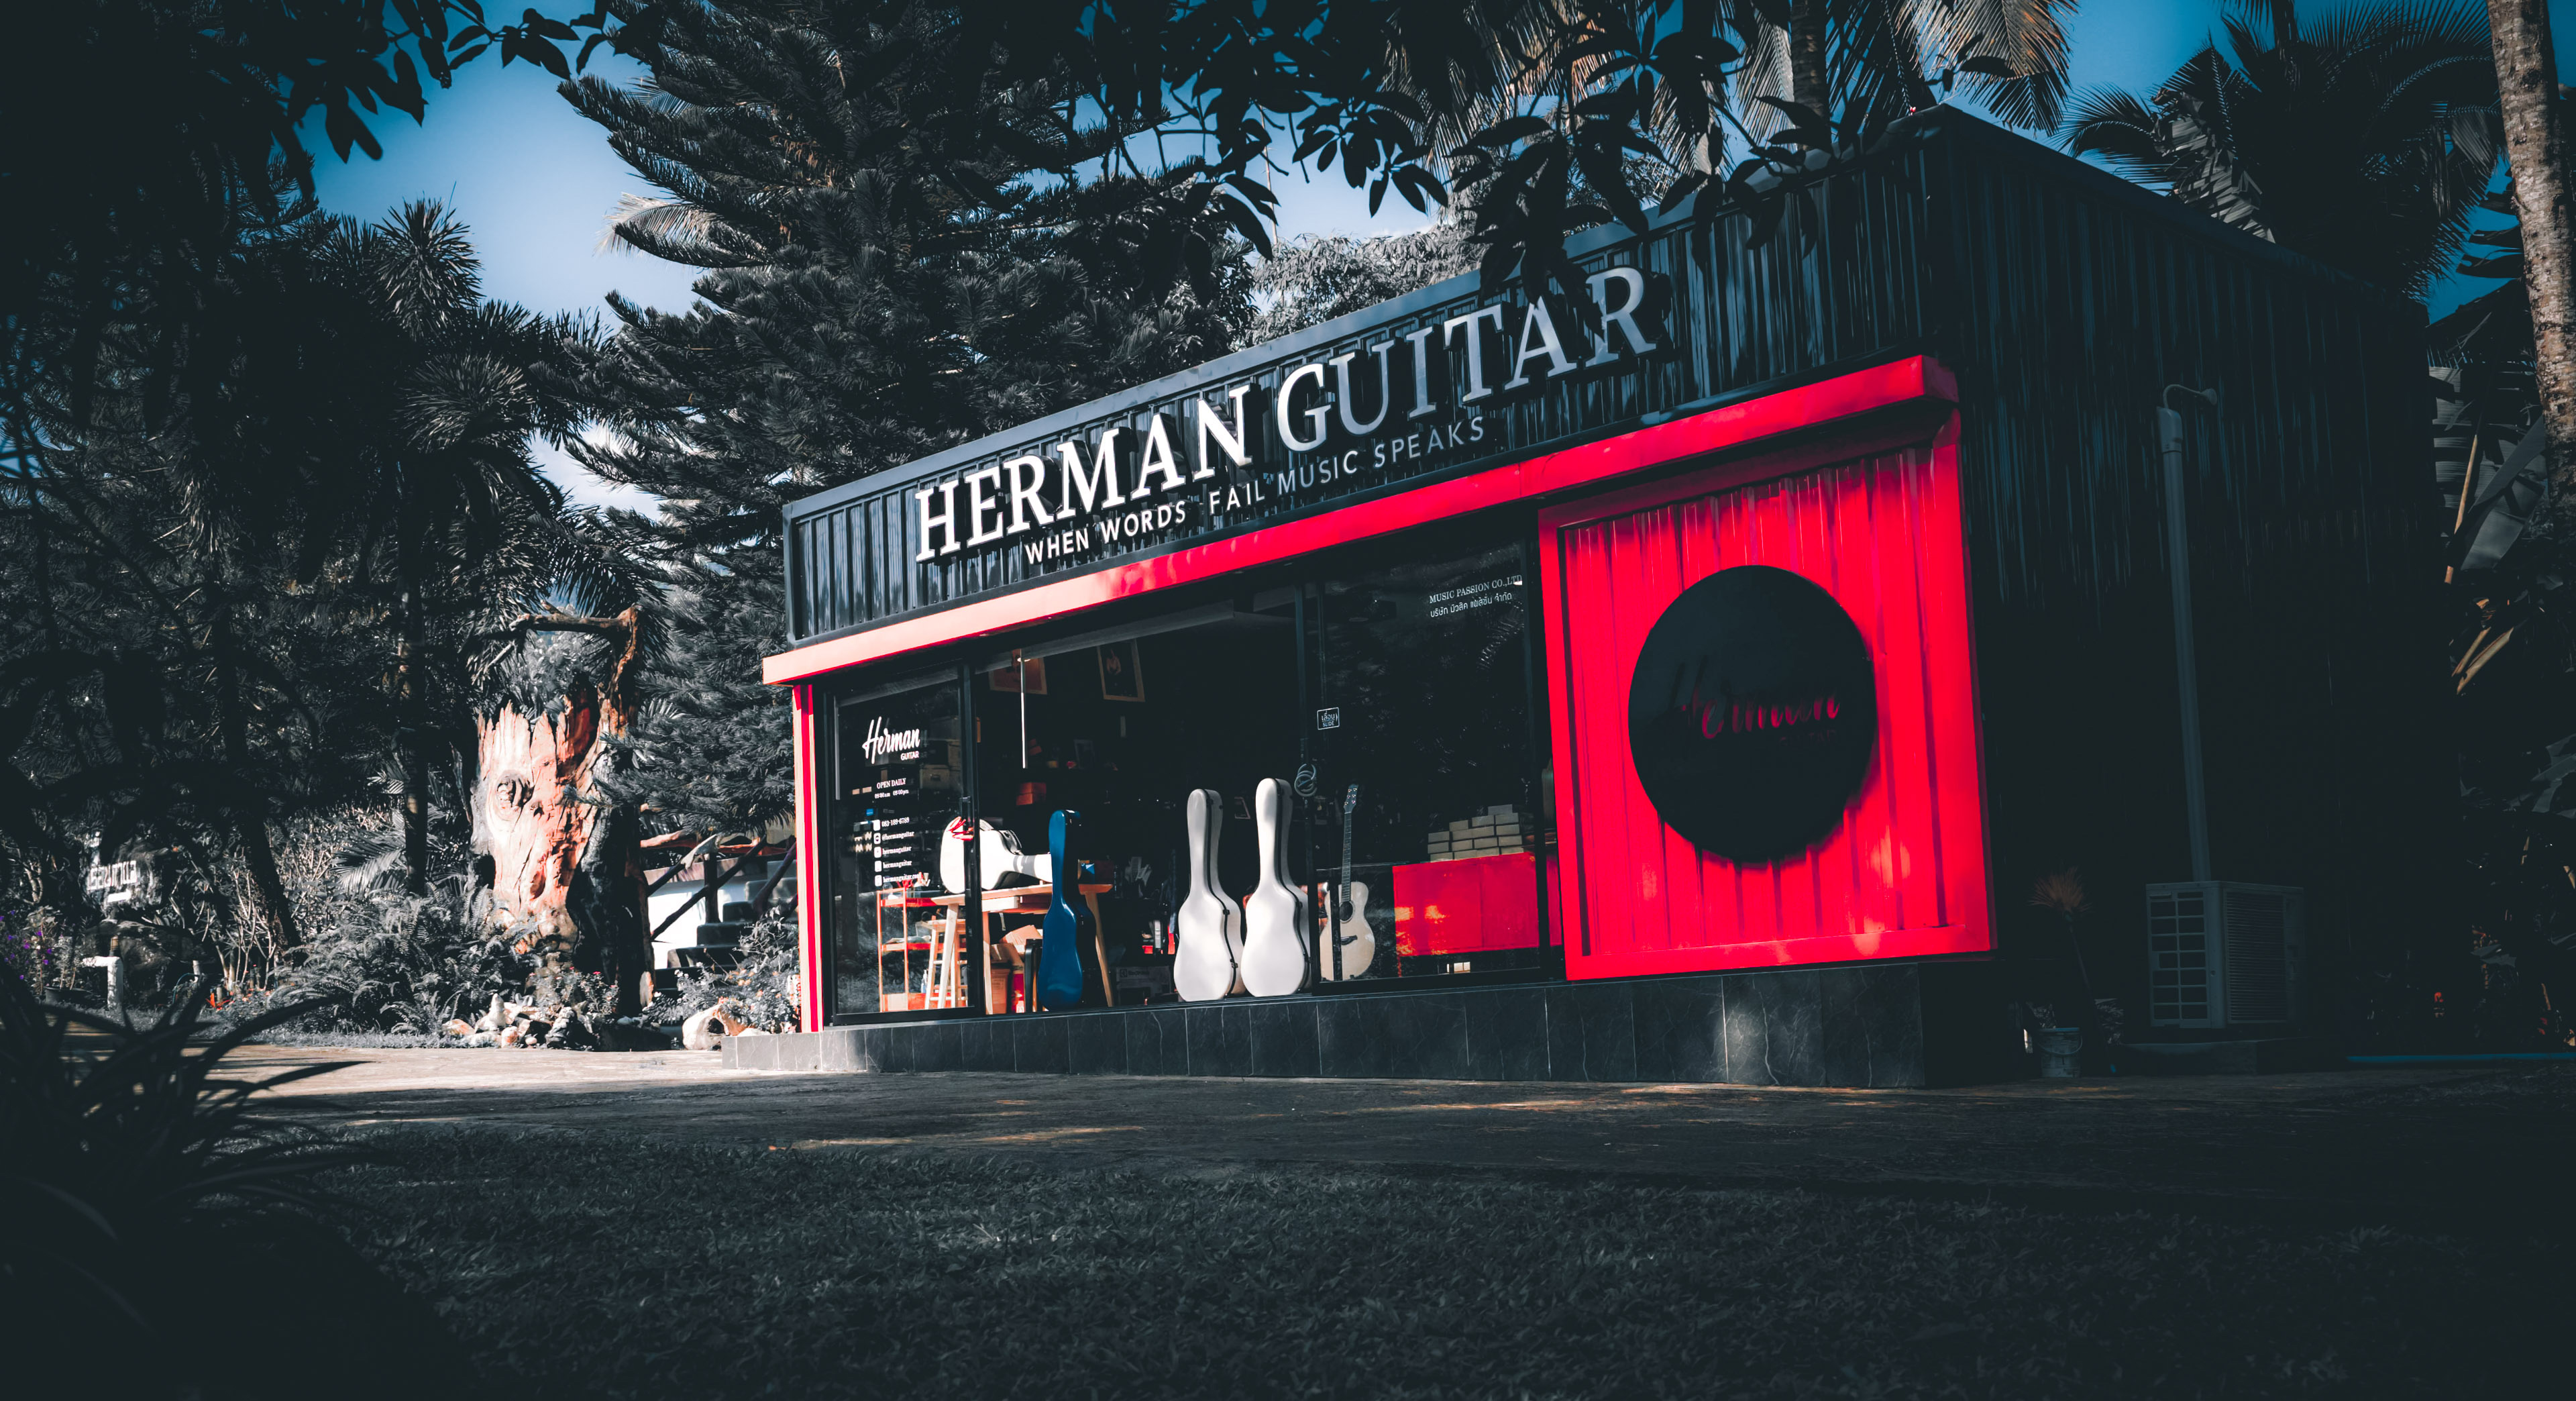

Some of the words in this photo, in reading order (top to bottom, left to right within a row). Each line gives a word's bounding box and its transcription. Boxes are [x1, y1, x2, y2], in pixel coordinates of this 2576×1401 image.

[915, 384, 1253, 562] HERMAN
[1277, 267, 1656, 452] GUITAR
[1025, 527, 1090, 565] WHEN
[1100, 500, 1186, 544] WORDS
[1209, 478, 1265, 515] FAIL
[1277, 450, 1359, 496] MUSIC
[1374, 416, 1485, 469] SPEAKS
[1430, 590, 1455, 604] MUSIC
[1456, 582, 1490, 597] PASSION
[862, 716, 920, 764] Herman
[900, 751, 919, 761] GUITAR
[877, 780, 891, 789] OPEN
[892, 778, 907, 787] DAILY
[881, 831, 914, 841] @hermanguitar
[882, 846, 912, 855] hermanguitar
[883, 860, 912, 868] hermanguitar
